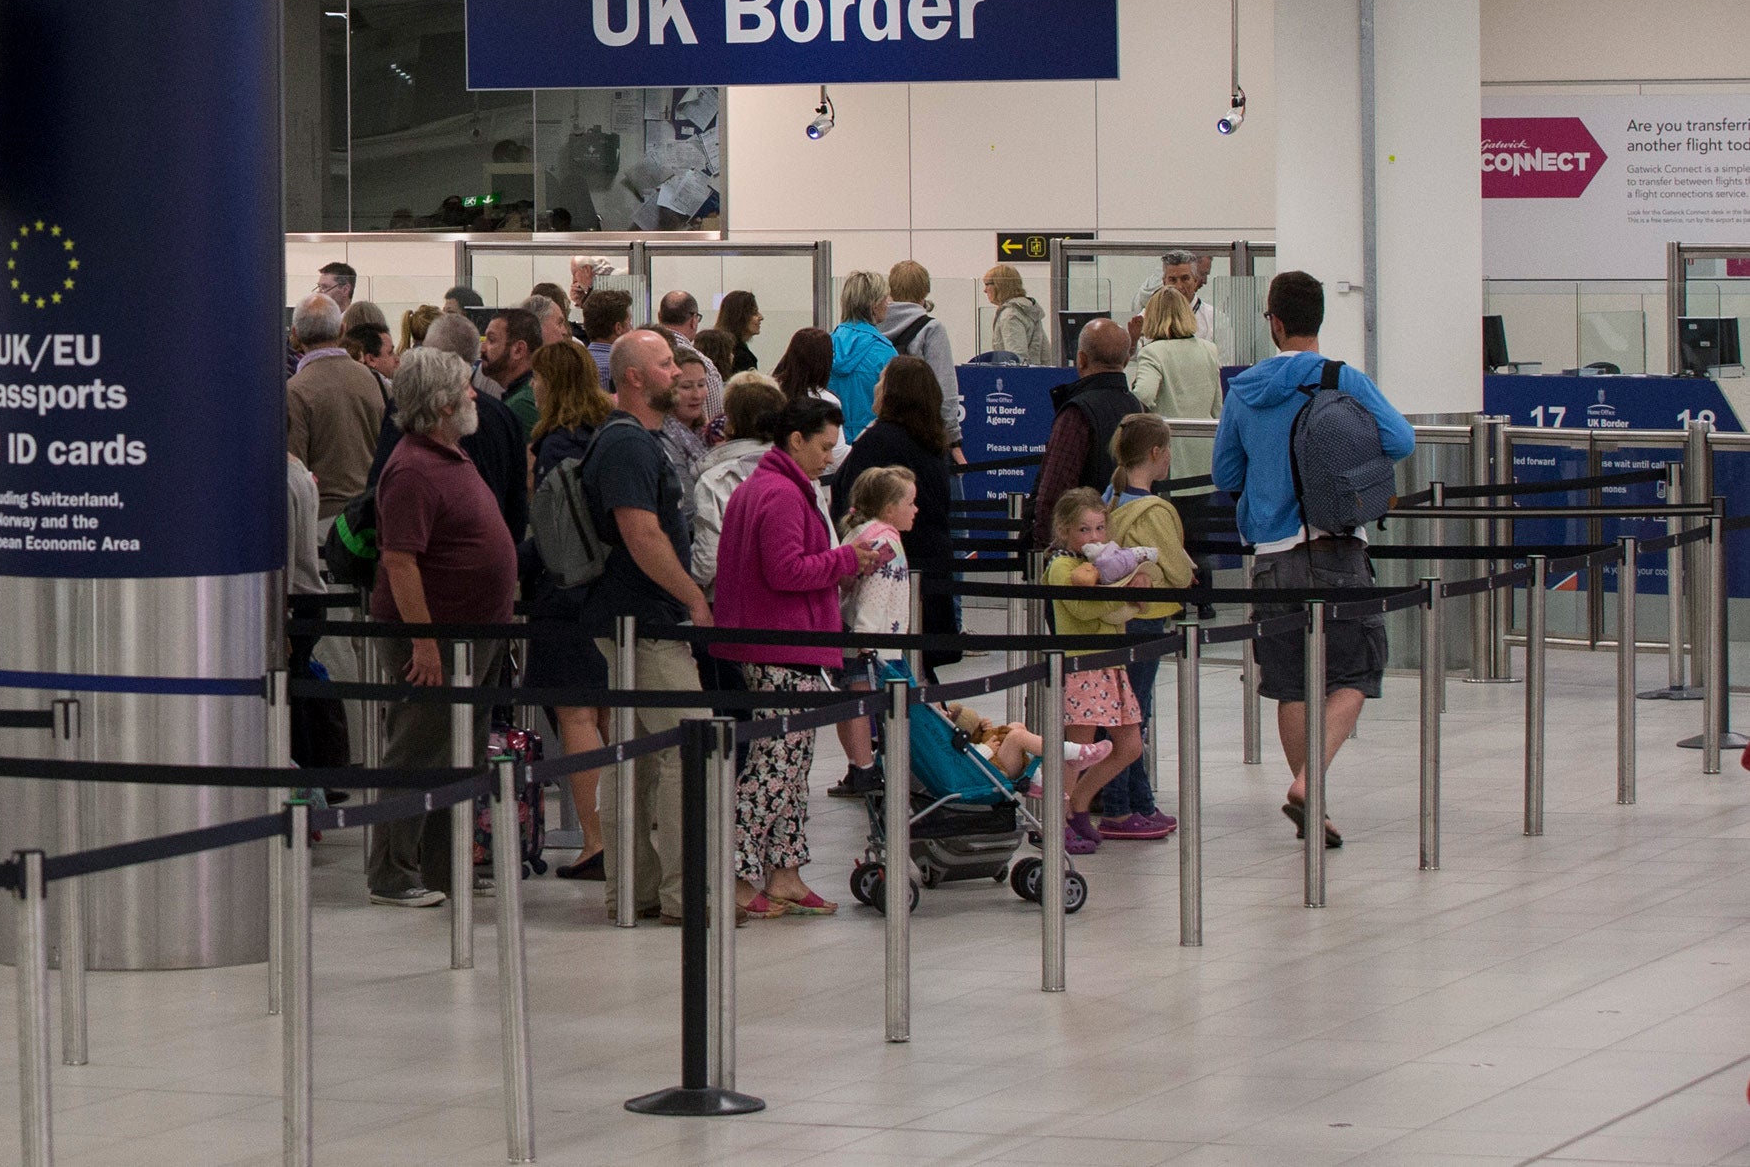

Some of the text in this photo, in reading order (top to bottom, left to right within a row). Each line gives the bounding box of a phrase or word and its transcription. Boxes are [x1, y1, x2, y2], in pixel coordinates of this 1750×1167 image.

[1626, 119, 1652, 132] Are
[1656, 122, 1682, 135] you
[1481, 139, 1531, 152] Gatwick
[1627, 138, 1682, 152] another
[1686, 138, 1723, 155] flight
[1481, 147, 1591, 176] CONNECT
[1626, 164, 1662, 174] Gatwick
[1664, 164, 1702, 173] Connect
[1704, 165, 1712, 173] is
[1721, 164, 1750, 175] simple
[1627, 178, 1637, 186] to
[1639, 177, 1672, 186] transfer
[1674, 177, 1713, 185] between
[1715, 176, 1742, 187] flights
[1635, 189, 1657, 200] flight
[1660, 190, 1713, 198] connections
[1715, 189, 1749, 198] service.
[986, 406, 1026, 415] UK Border
[986, 416, 1016, 425] Agency
[1530, 406, 1566, 427] 17
[1587, 419, 1629, 428] UK Border
[8, 432, 37, 464] ID
[47, 434, 147, 465] cards
[987, 444, 1046, 452] Please wait until
[1527, 457, 1555, 465] forward
[1614, 460, 1631, 468] wait
[1632, 460, 1649, 468] until
[998, 468, 1024, 476] phones
[31, 491, 124, 509] Switzerland,
[987, 491, 997, 499] No
[41, 514, 68, 529] and
[72, 514, 99, 529] the
[25, 535, 97, 551] Economic
[101, 536, 141, 551] Area
